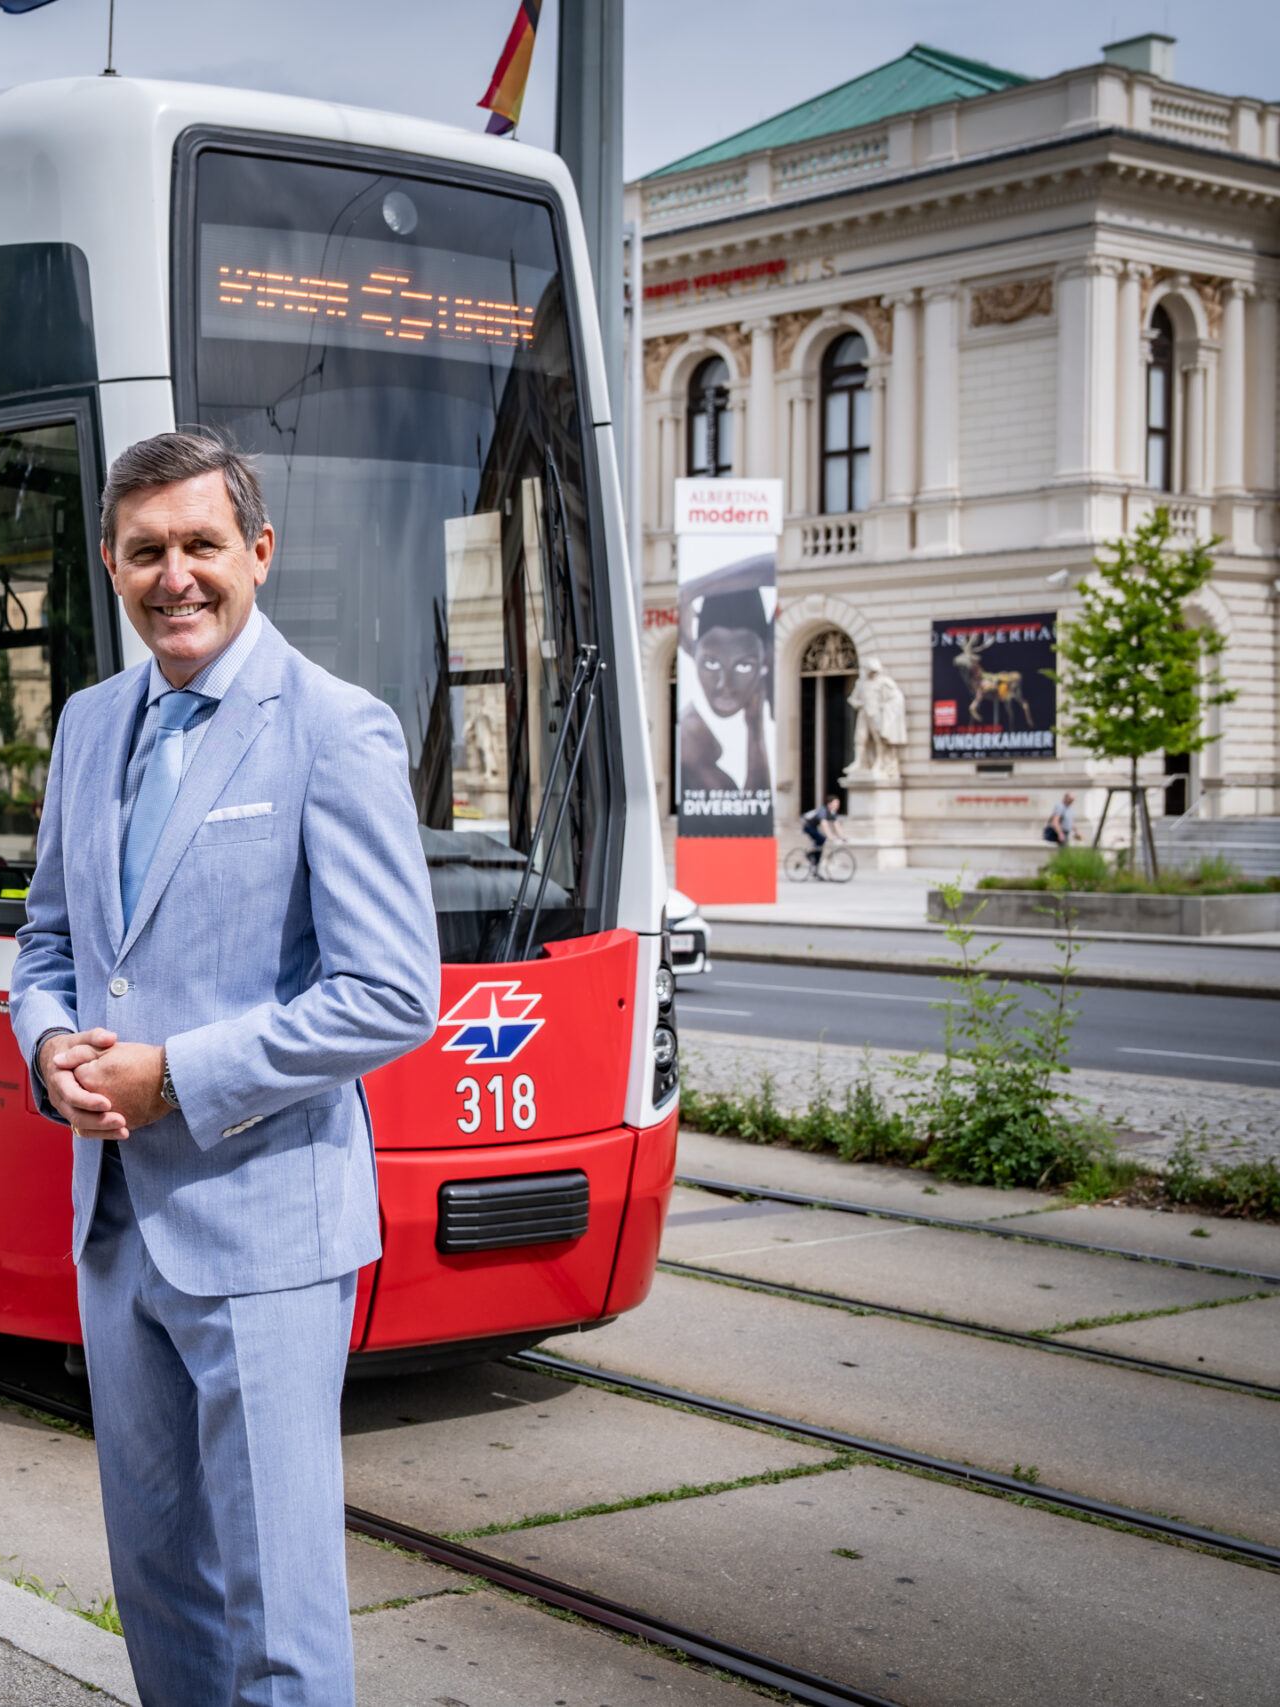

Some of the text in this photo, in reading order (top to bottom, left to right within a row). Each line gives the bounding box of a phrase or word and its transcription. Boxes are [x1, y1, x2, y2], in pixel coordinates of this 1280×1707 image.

[690, 490, 768, 504] ALBERTINA
[688, 507, 768, 522] modern
[933, 731, 1054, 751] WUNDERKAMMER
[683, 799, 770, 816] DIVERSITY
[455, 1073, 537, 1134] 318
